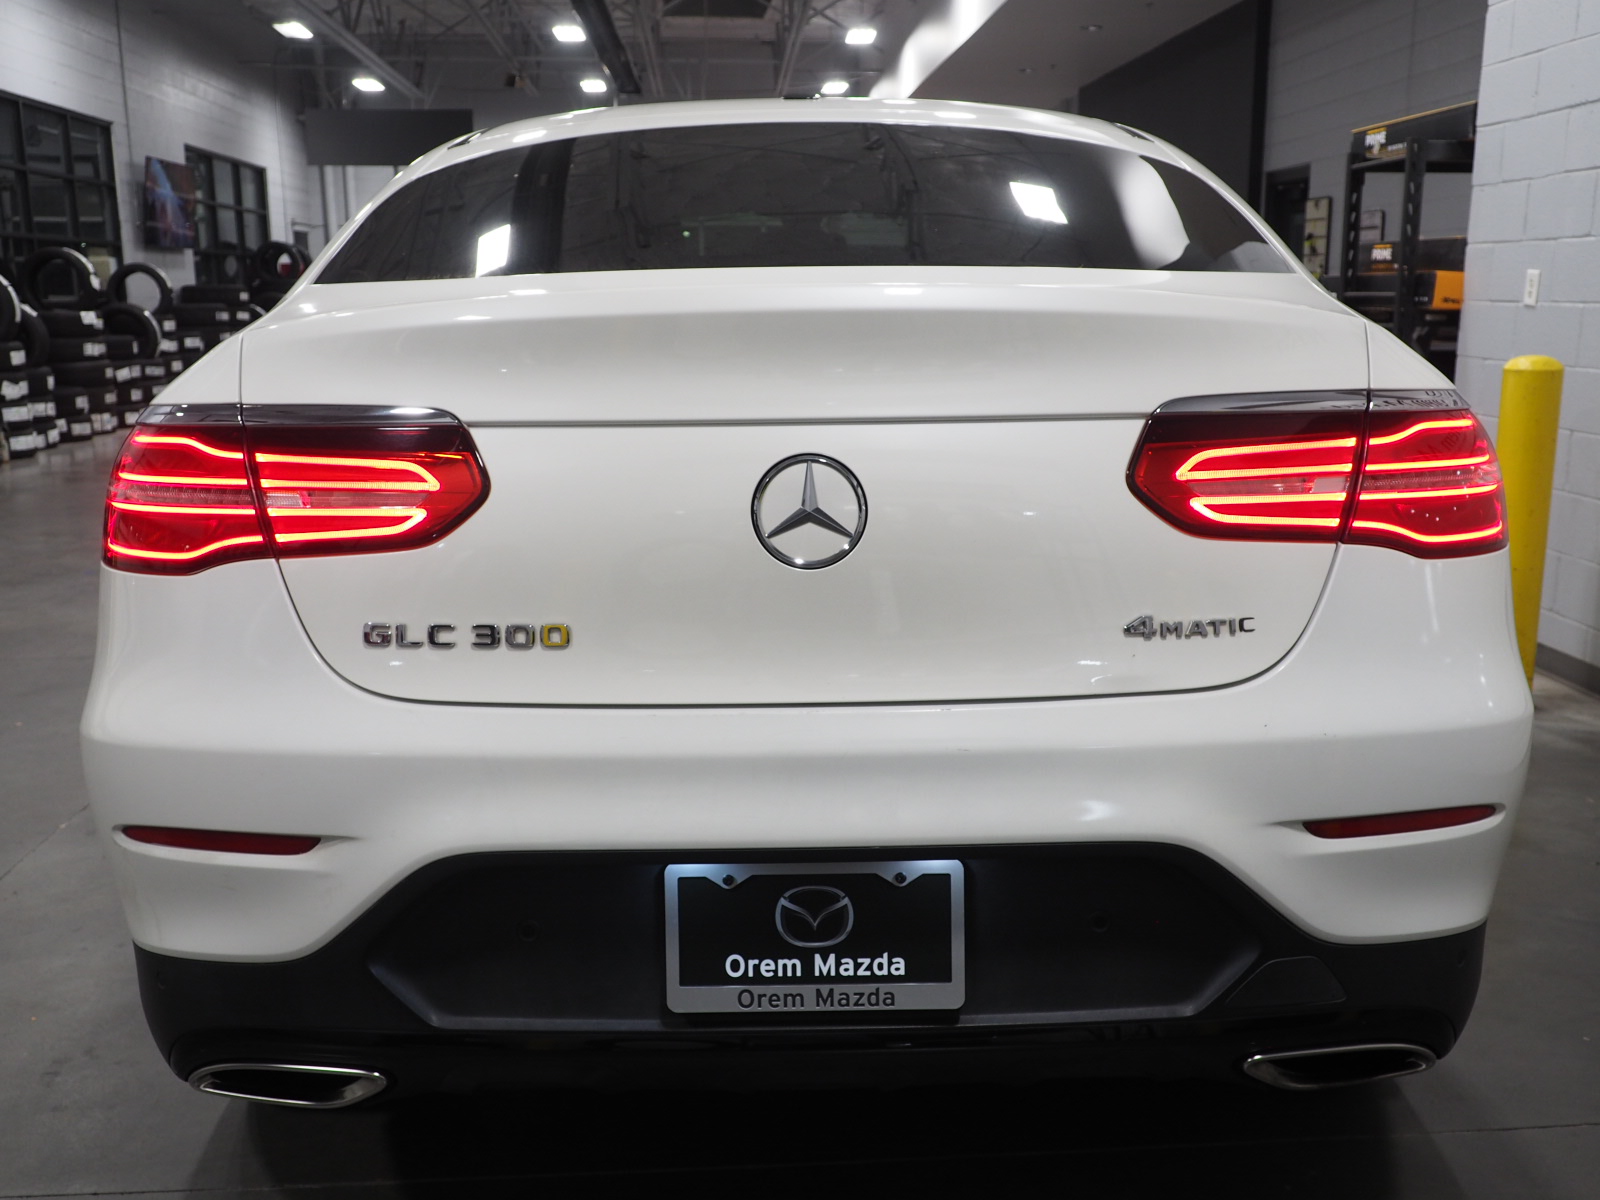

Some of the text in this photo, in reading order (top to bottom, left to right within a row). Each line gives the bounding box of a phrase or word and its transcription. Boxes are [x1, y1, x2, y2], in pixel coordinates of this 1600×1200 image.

[363, 622, 573, 648] GLC 300
[1123, 615, 1256, 641] 4MATIC
[725, 952, 906, 978] Orem Mazda
[737, 987, 895, 1009] Orem Mazda
